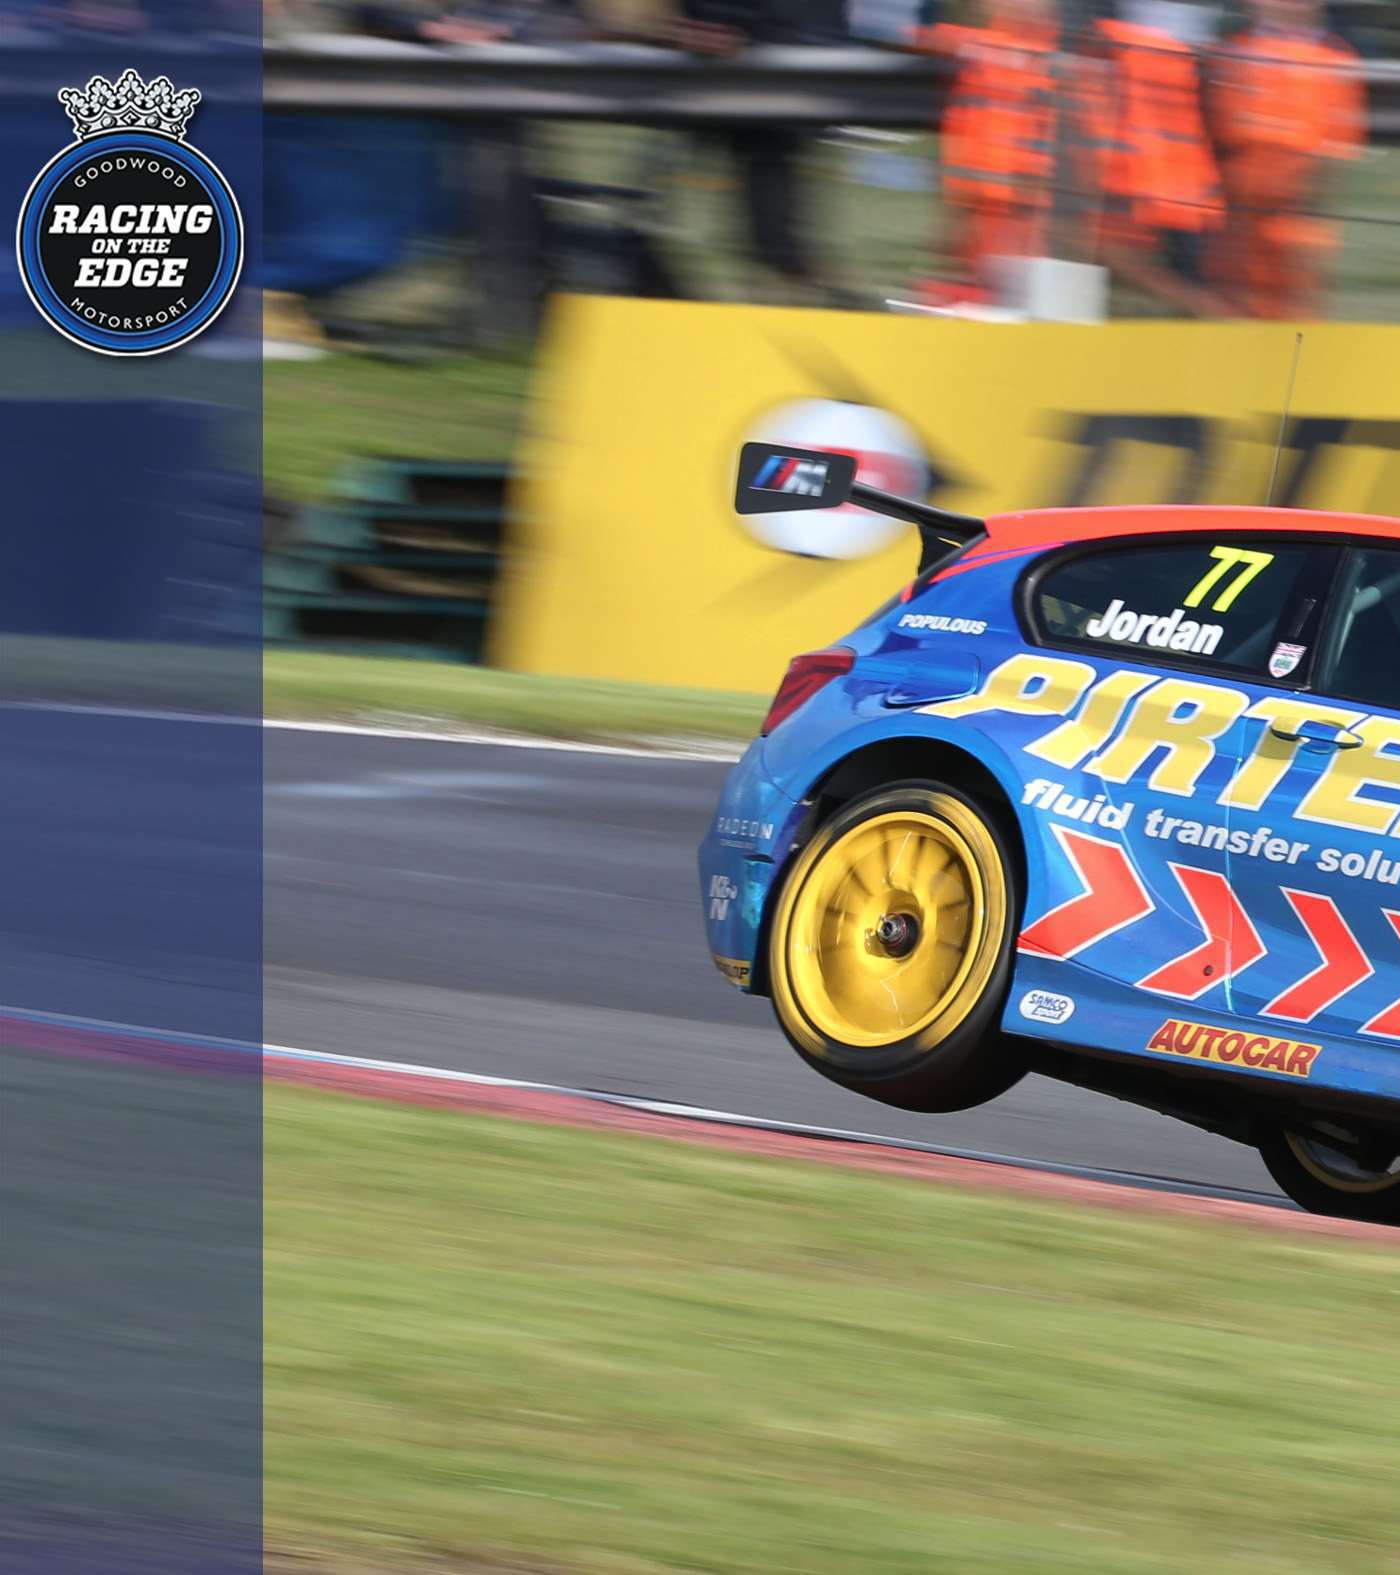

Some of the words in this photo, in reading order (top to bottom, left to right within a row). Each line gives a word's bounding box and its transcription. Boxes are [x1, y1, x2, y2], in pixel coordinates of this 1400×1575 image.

[1184, 545, 1276, 612] 77
[898, 614, 988, 635] POPULOUS
[1086, 600, 1224, 655] Jordan
[717, 817, 774, 840] RADEON
[1020, 778, 1135, 831] fluid
[1144, 808, 1310, 865] transfer
[1149, 1020, 1318, 1076] AUTOCAR
